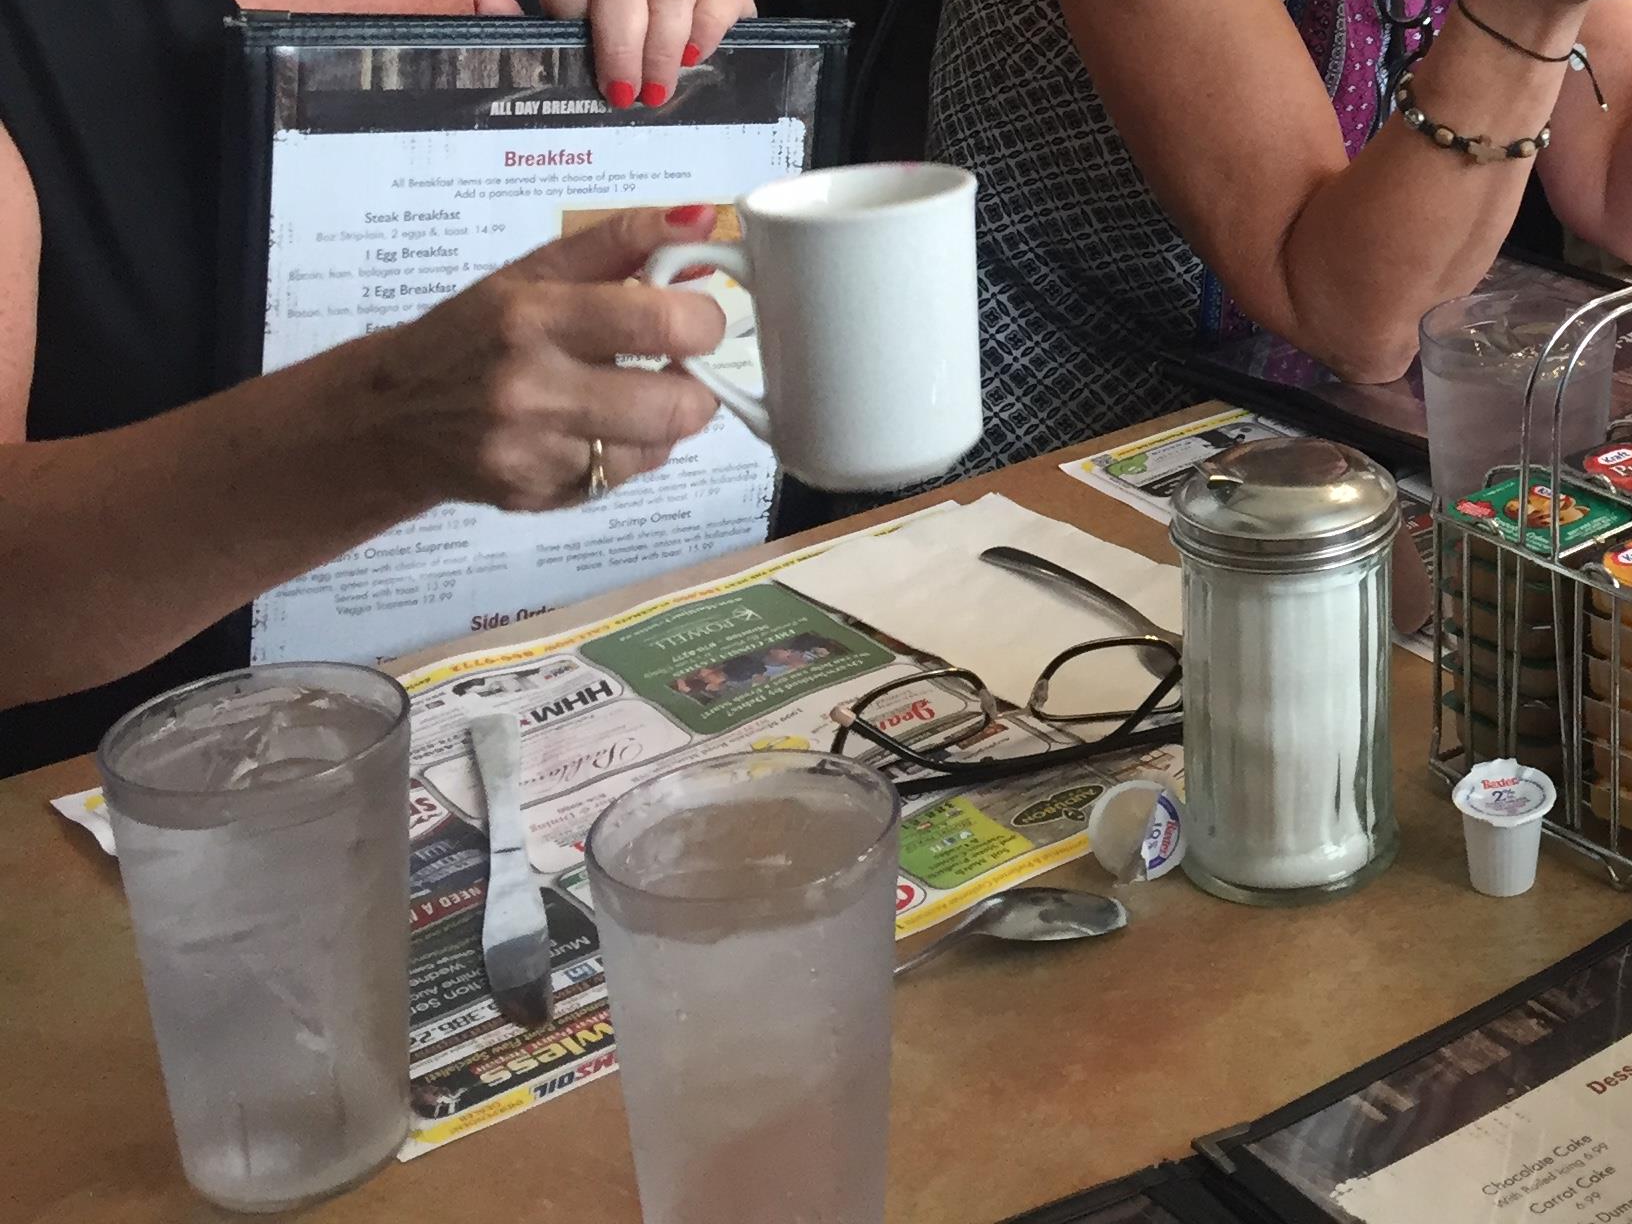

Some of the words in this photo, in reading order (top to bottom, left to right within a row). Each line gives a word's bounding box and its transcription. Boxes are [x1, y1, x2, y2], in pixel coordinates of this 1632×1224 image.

[490, 101, 512, 116] ALL
[515, 100, 540, 114] DAY
[542, 100, 612, 114] BREAKFAS
[504, 150, 593, 167] Breakfast
[454, 189, 475, 199] Add
[613, 183, 636, 193] 1.99
[365, 212, 399, 224] Steak
[403, 210, 461, 222] Breakfast
[376, 249, 397, 263] Egg
[402, 246, 459, 258] Breakfast
[362, 287, 370, 298] 2
[374, 286, 396, 299] Egg
[400, 283, 457, 294] Breakfast
[667, 454, 699, 466] melet
[1604, 449, 1632, 465] Kraft
[608, 516, 647, 530] Shrimp
[650, 509, 692, 523] Omelet
[364, 545, 412, 560] Omelet
[415, 539, 470, 554] Supreme
[471, 612, 510, 632] Side
[529, 680, 612, 723] HHM
[1021, 786, 1096, 824] AUDUBON
[437, 882, 480, 909] NEED
[1482, 1151, 1553, 1199] Chocolate
[1552, 1129, 1592, 1160] Cake
[1528, 1182, 1577, 1217] Carrot
[1574, 1160, 1617, 1192] Cake
[1574, 1190, 1602, 1211] 6.99
